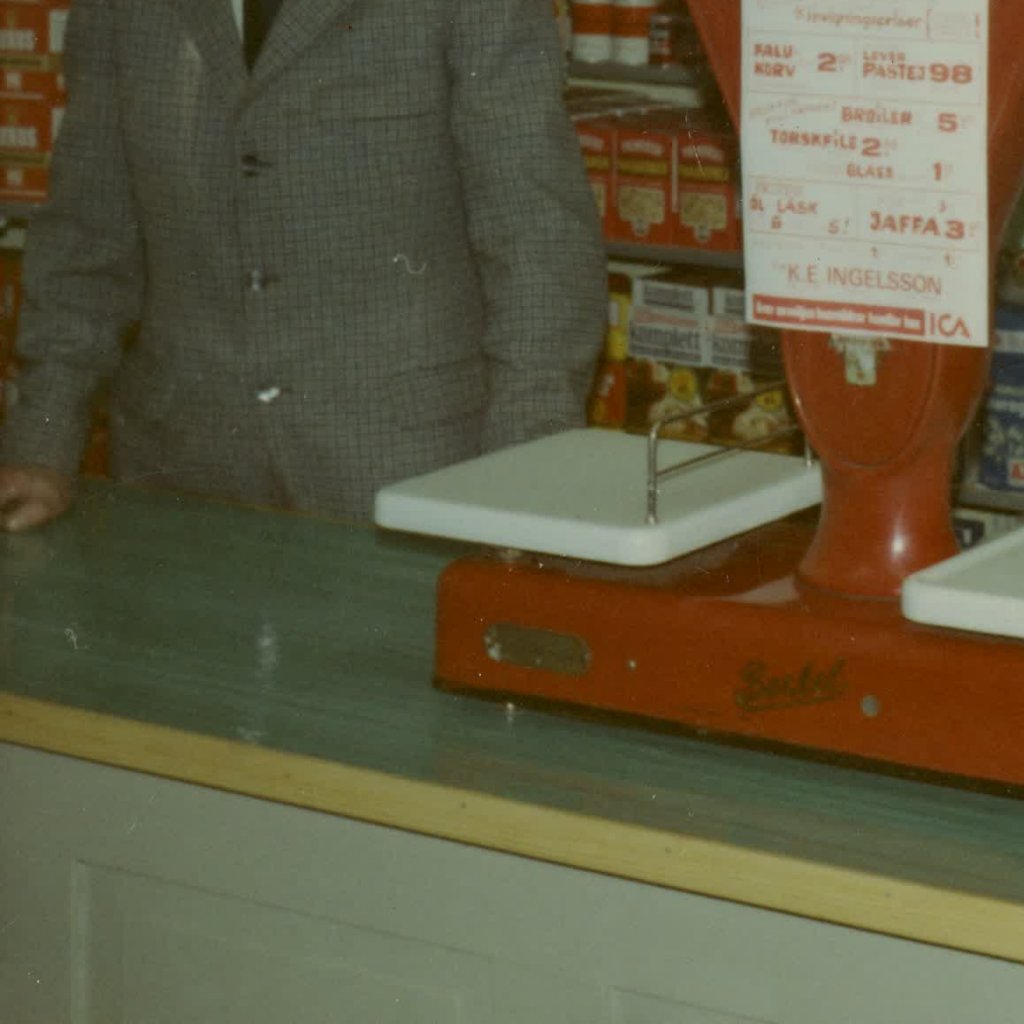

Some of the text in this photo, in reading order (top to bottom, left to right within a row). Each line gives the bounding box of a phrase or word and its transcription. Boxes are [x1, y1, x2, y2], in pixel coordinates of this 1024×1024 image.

[928, 62, 974, 84] 98
[869, 211, 940, 237] JAFFA
[828, 266, 942, 296] INGELSSON
[930, 313, 970, 339] ICA
